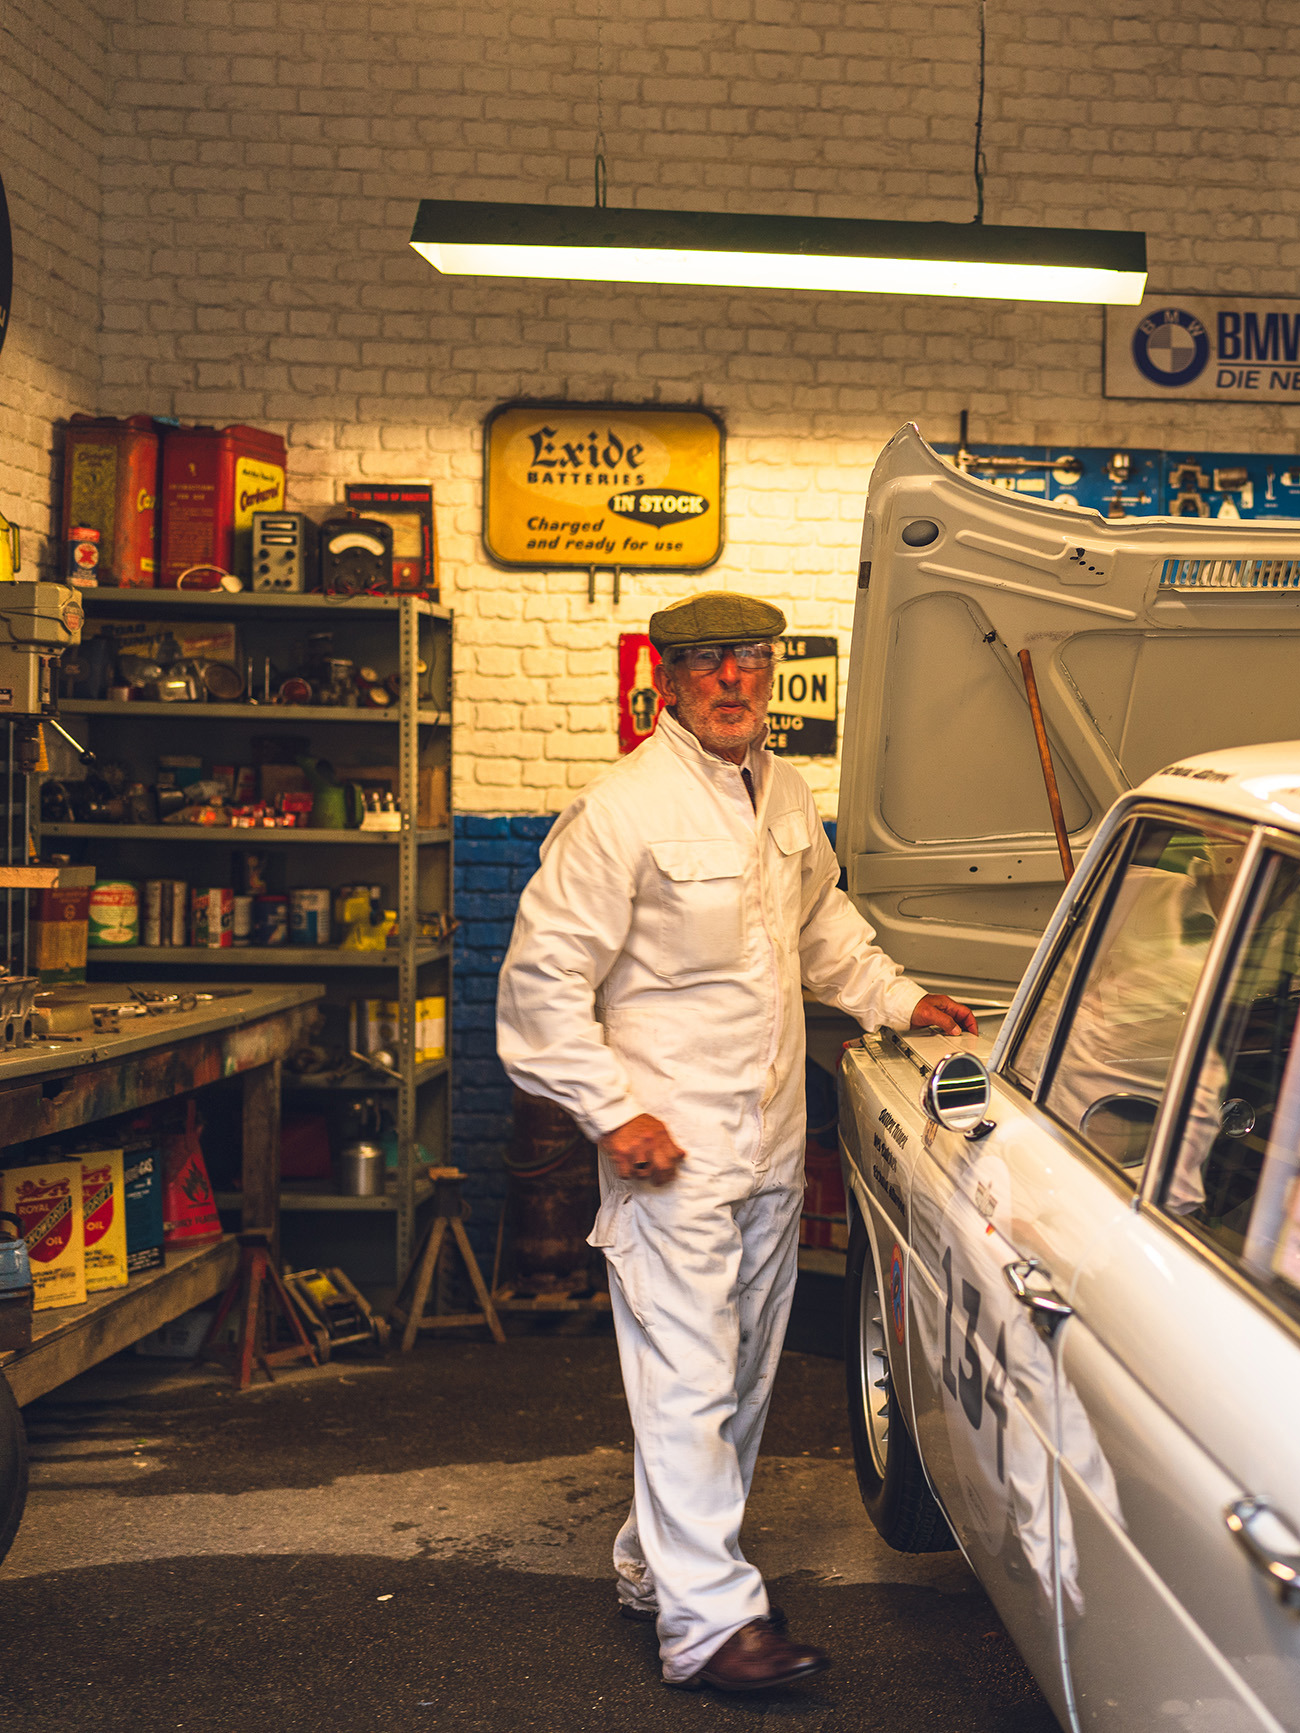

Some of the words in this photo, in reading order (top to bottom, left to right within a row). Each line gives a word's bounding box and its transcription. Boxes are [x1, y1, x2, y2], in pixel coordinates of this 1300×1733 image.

[1216, 369, 1261, 390] DIE
[528, 424, 644, 469] Exide
[527, 472, 645, 486] BATTERIES
[613, 494, 636, 512] IN
[639, 494, 705, 514] STOCK
[527, 516, 605, 535] Charged
[527, 536, 561, 550] and
[565, 536, 616, 554] ready
[622, 536, 648, 551] for
[655, 541, 683, 551] use
[18, 1203, 50, 1215] ROYAL
[86, 1221, 104, 1232] OIL
[45, 1236, 64, 1247] OIL
[941, 1246, 1008, 1485] 134
